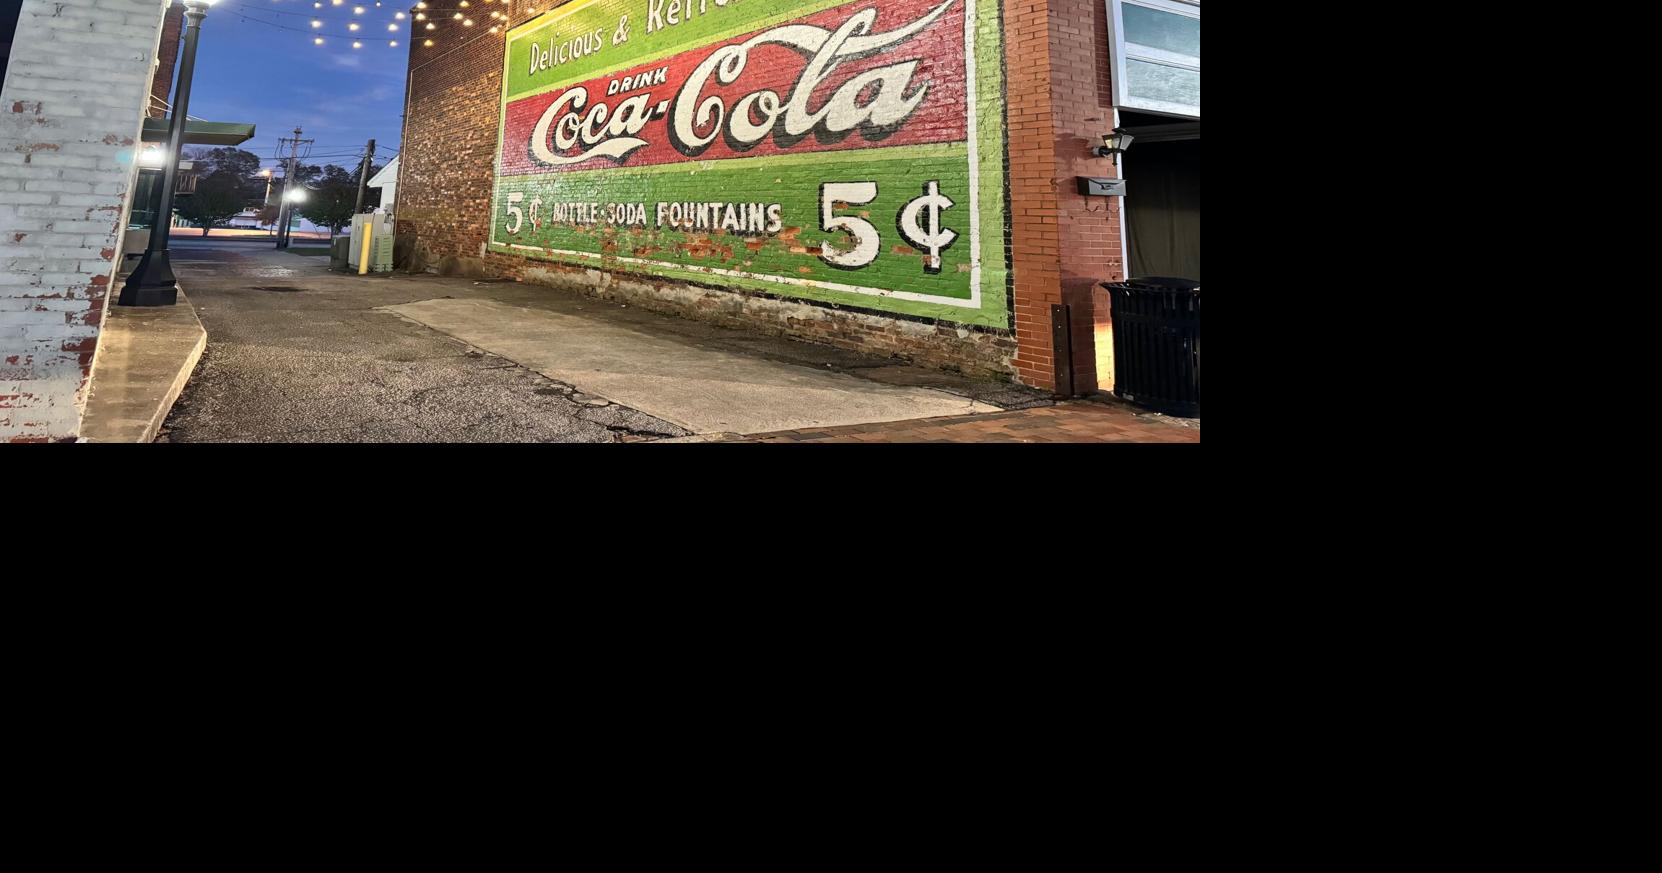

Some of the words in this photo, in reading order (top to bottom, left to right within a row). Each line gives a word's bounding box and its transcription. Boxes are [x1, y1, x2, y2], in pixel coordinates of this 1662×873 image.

[529, 27, 603, 75] Delicious
[612, 15, 631, 46] &
[529, 0, 953, 166] Coca-Cola
[607, 66, 669, 97] DRINK
[655, 201, 782, 235] FOUNTAINS
